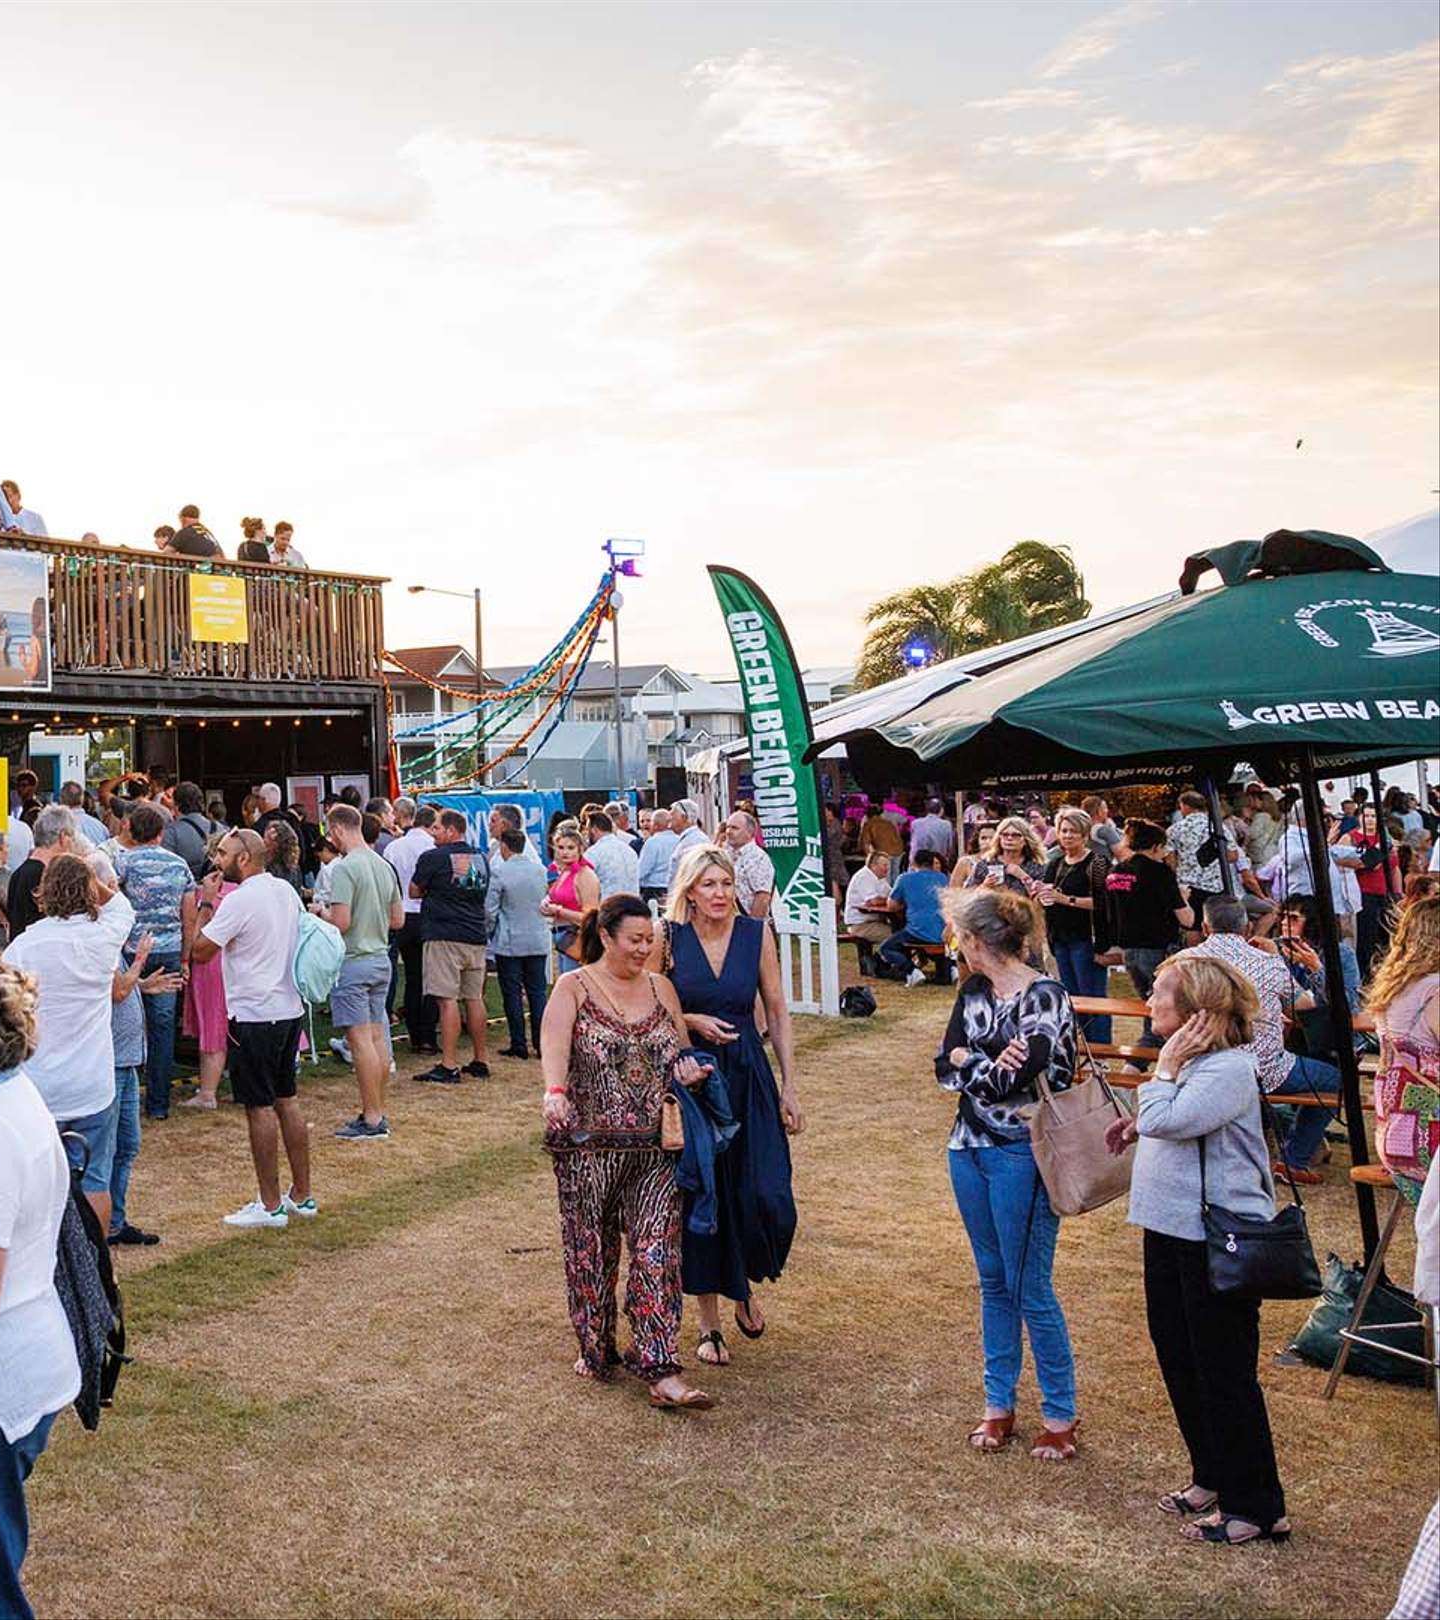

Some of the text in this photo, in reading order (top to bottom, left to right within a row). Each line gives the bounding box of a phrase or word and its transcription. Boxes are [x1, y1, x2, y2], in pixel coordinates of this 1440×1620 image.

[727, 610, 800, 826] GREEN BEACON
[1252, 701, 1371, 724] GREEN
